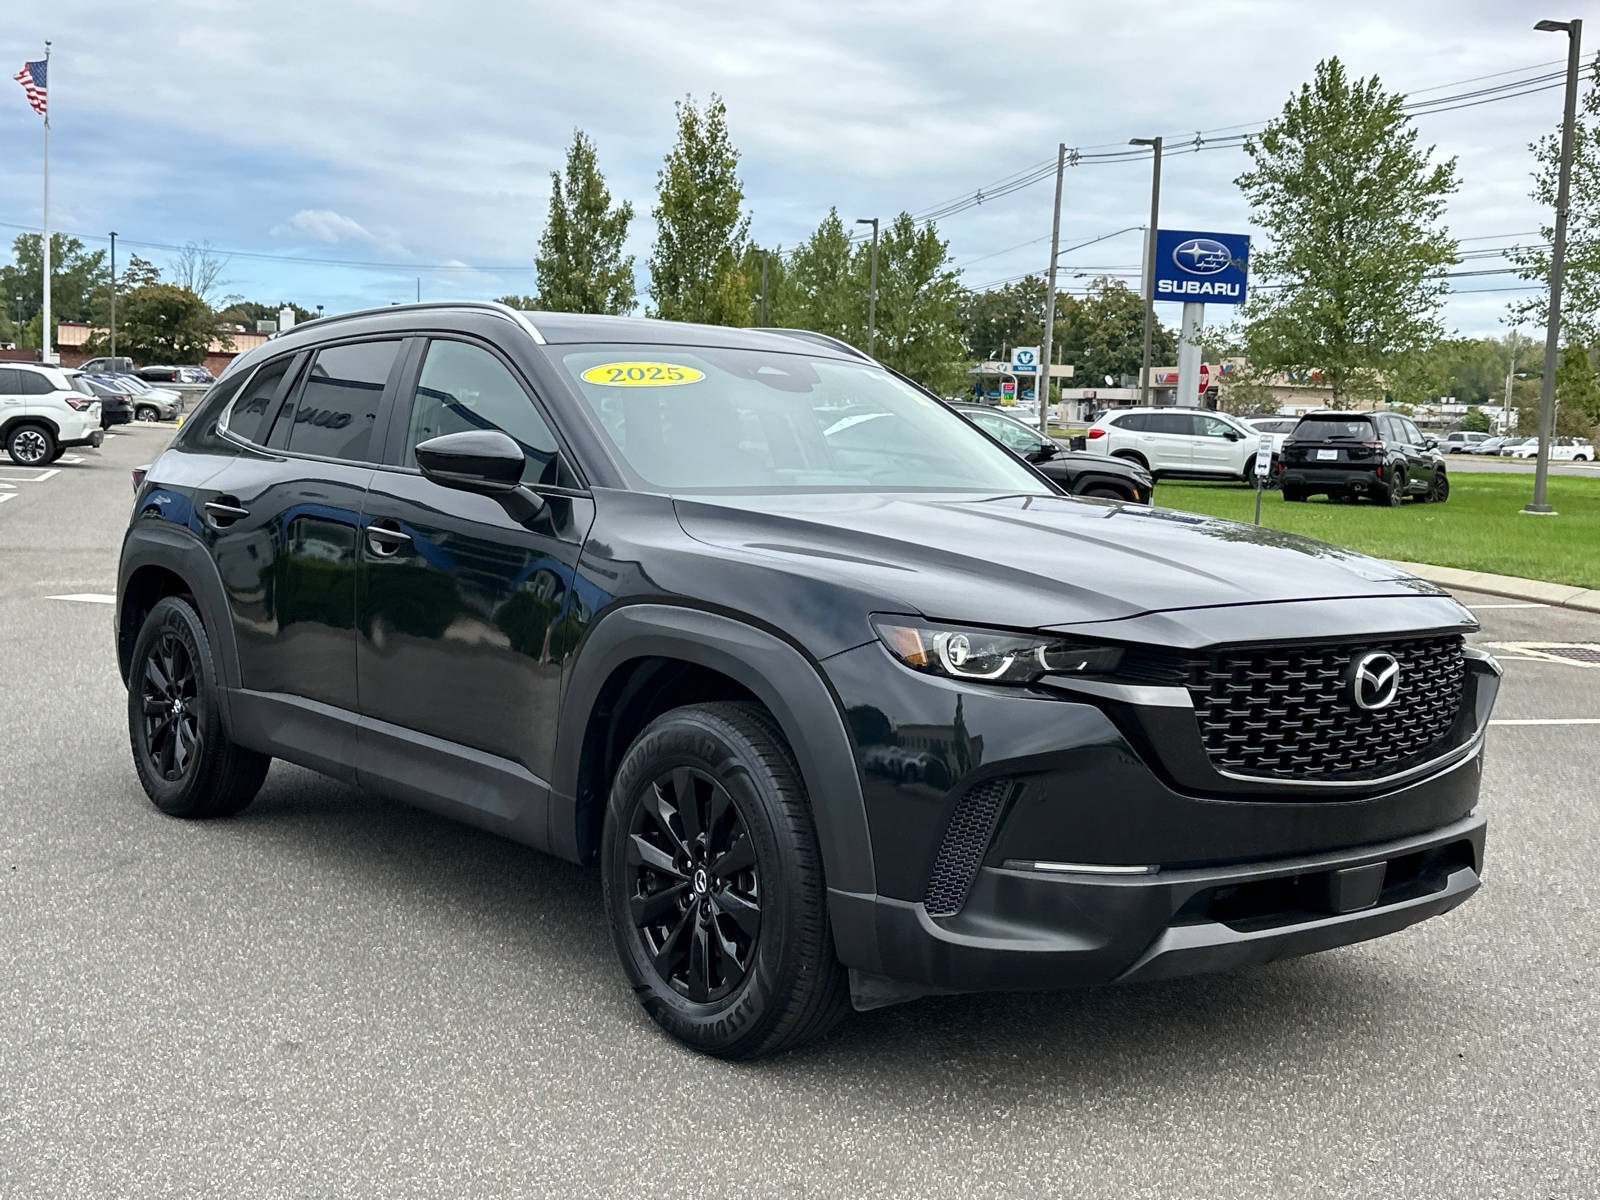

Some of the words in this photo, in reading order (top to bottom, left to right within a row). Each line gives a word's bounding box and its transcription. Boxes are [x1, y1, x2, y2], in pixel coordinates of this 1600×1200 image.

[1158, 279, 1240, 297] SUBARU
[606, 367, 684, 382] 2025
[1199, 373, 1209, 385] TOP
